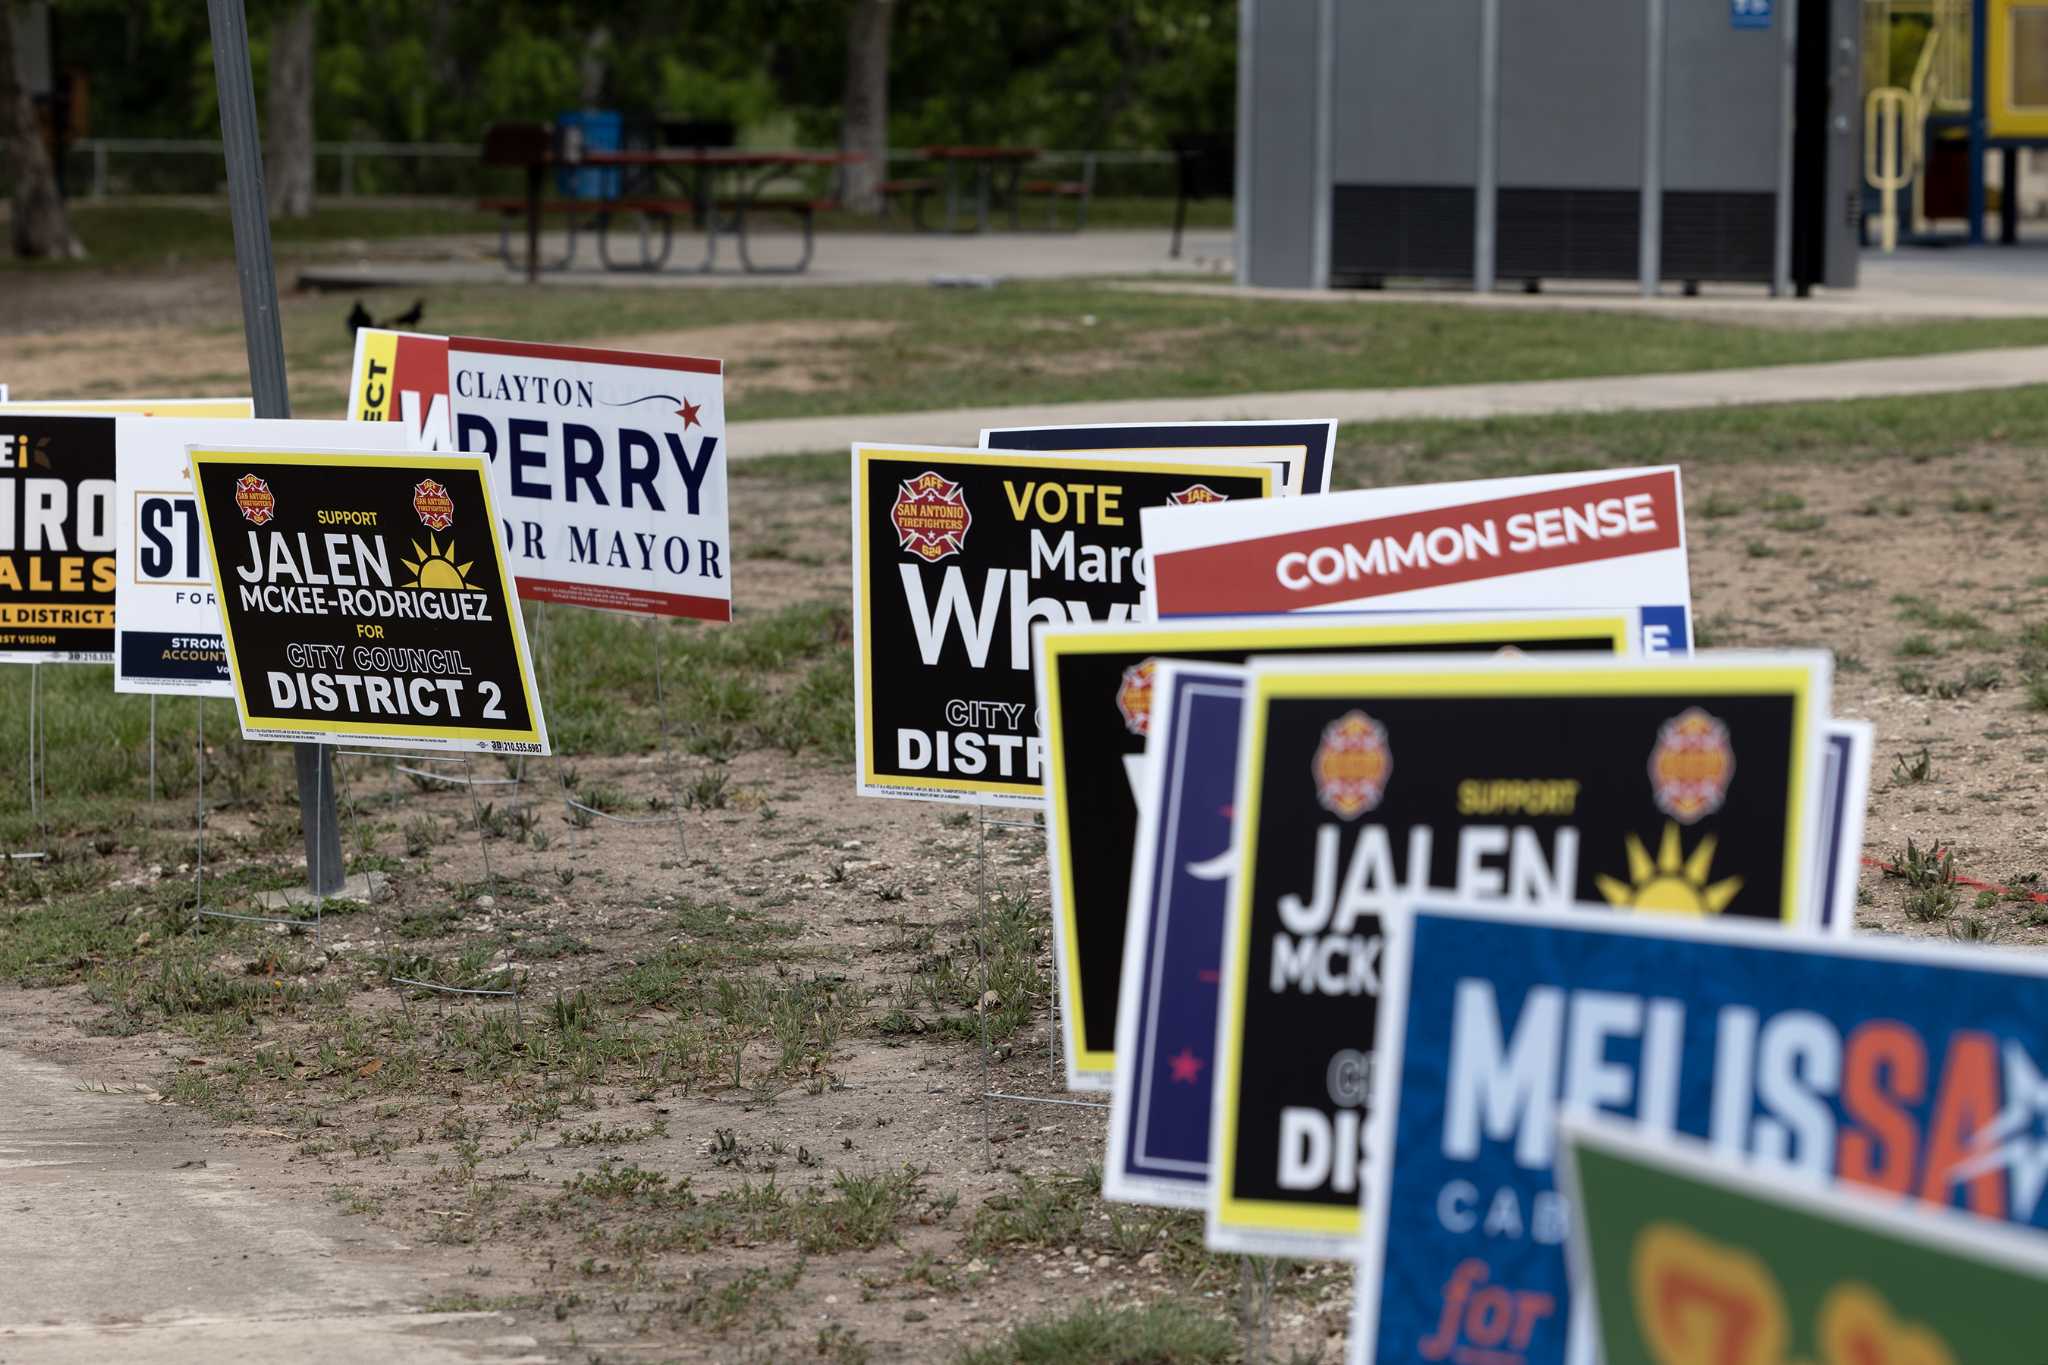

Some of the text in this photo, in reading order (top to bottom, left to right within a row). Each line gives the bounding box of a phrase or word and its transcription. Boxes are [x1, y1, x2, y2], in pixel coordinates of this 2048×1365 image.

[456, 369, 593, 408] CLAYTON
[457, 413, 718, 515] PERRY
[919, 476, 944, 490] IAFF
[317, 510, 377, 526] SUPPORT
[898, 503, 964, 518] SAN ANTONIO
[1003, 481, 1124, 526] VOTE
[899, 517, 963, 529] FIREFIGHTERS
[1276, 492, 1657, 590] COMMON SENSE
[237, 531, 393, 588] JALEN
[568, 525, 723, 579] MAYOR
[17, 608, 105, 624] DISTRICT
[176, 592, 216, 605] FOR
[239, 585, 492, 621] MCKEE-RODRIGUEZ
[18, 635, 56, 645] VISION
[357, 624, 384, 639] FOR
[286, 643, 472, 675] CITY COUNCIL
[267, 671, 507, 720] DISTRICT 2
[945, 699, 1026, 730] CITY
[1457, 779, 1580, 815] SUPPORT
[1441, 976, 2005, 1222] MELISSA
[1417, 1256, 1556, 1362] for
